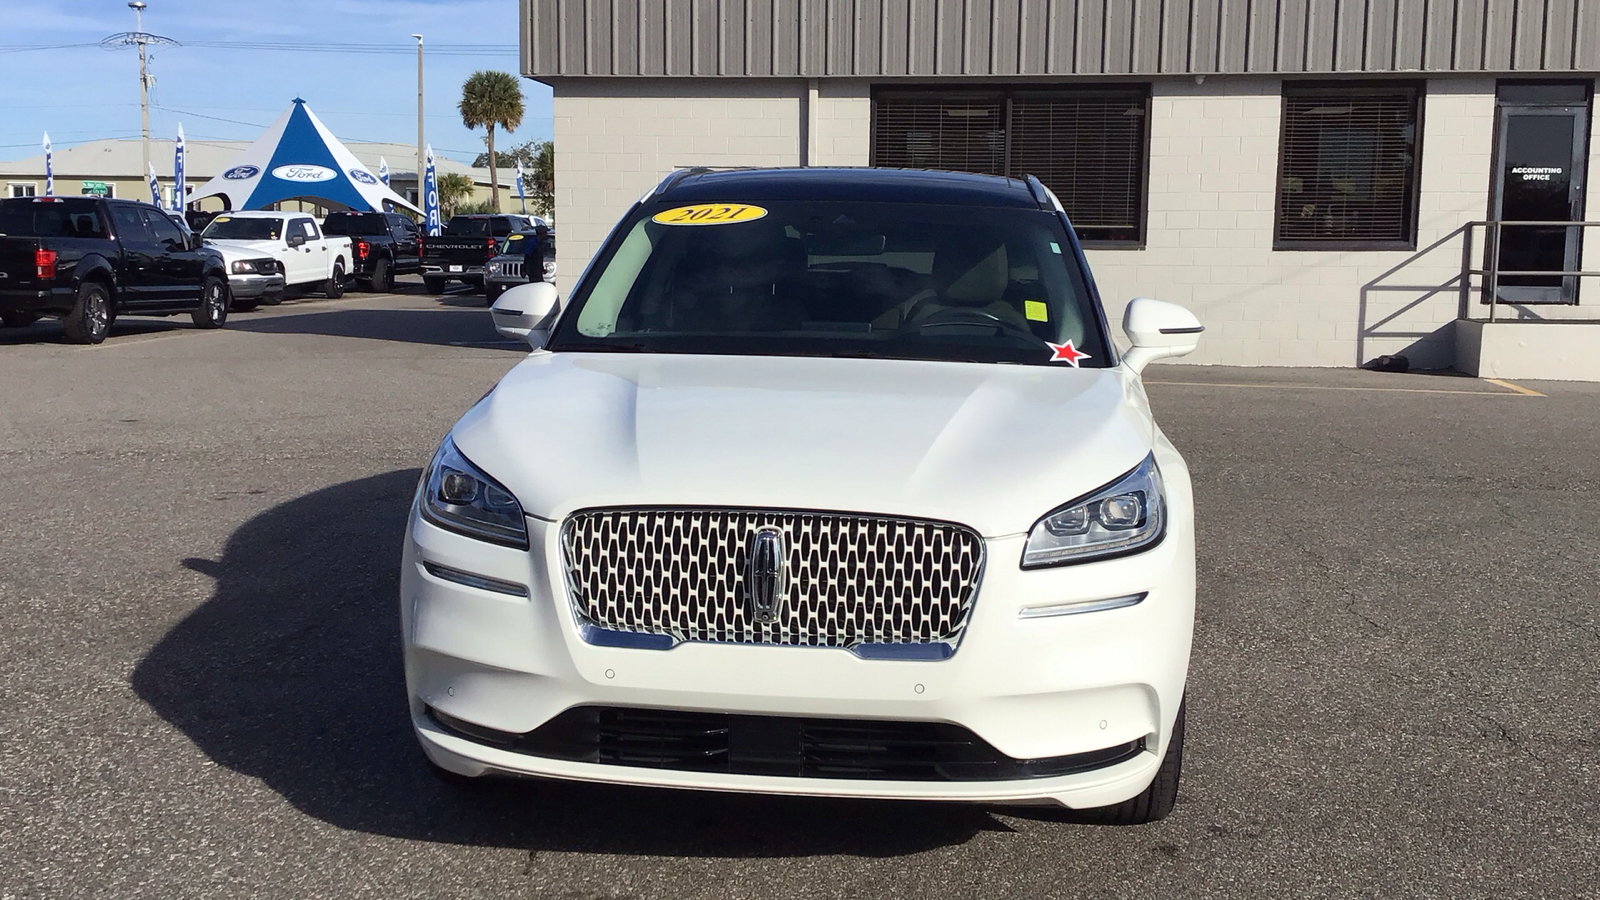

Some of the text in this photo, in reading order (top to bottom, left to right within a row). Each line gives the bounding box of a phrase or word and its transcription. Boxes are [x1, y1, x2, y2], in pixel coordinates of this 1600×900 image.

[227, 166, 255, 179] Ford
[286, 167, 324, 179] Ford
[670, 207, 747, 221] 2021
